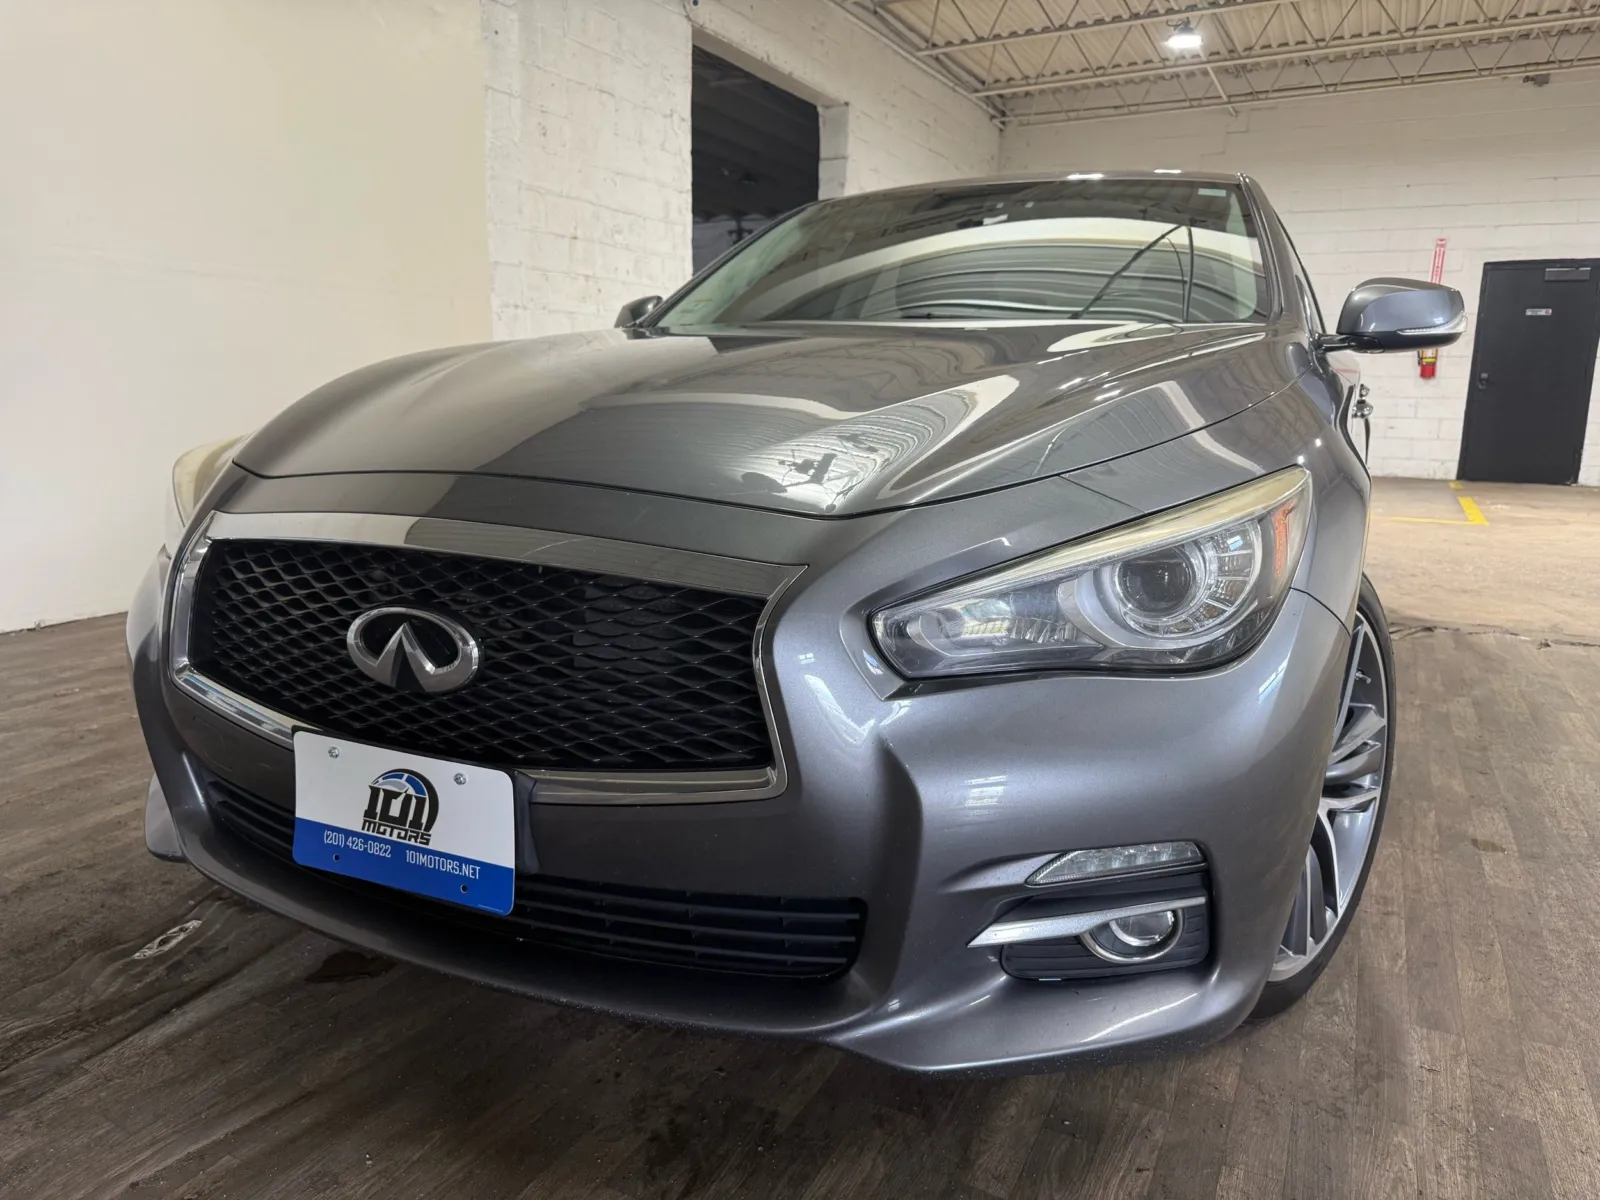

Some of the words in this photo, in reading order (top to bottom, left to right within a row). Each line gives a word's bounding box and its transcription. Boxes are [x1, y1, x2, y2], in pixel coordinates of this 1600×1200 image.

[363, 785, 427, 831] 101
[323, 830, 345, 848] (201)
[346, 836, 392, 858] 426-0822
[405, 850, 481, 879] 101MOTORS.NET
[361, 819, 432, 846] MOTORS
